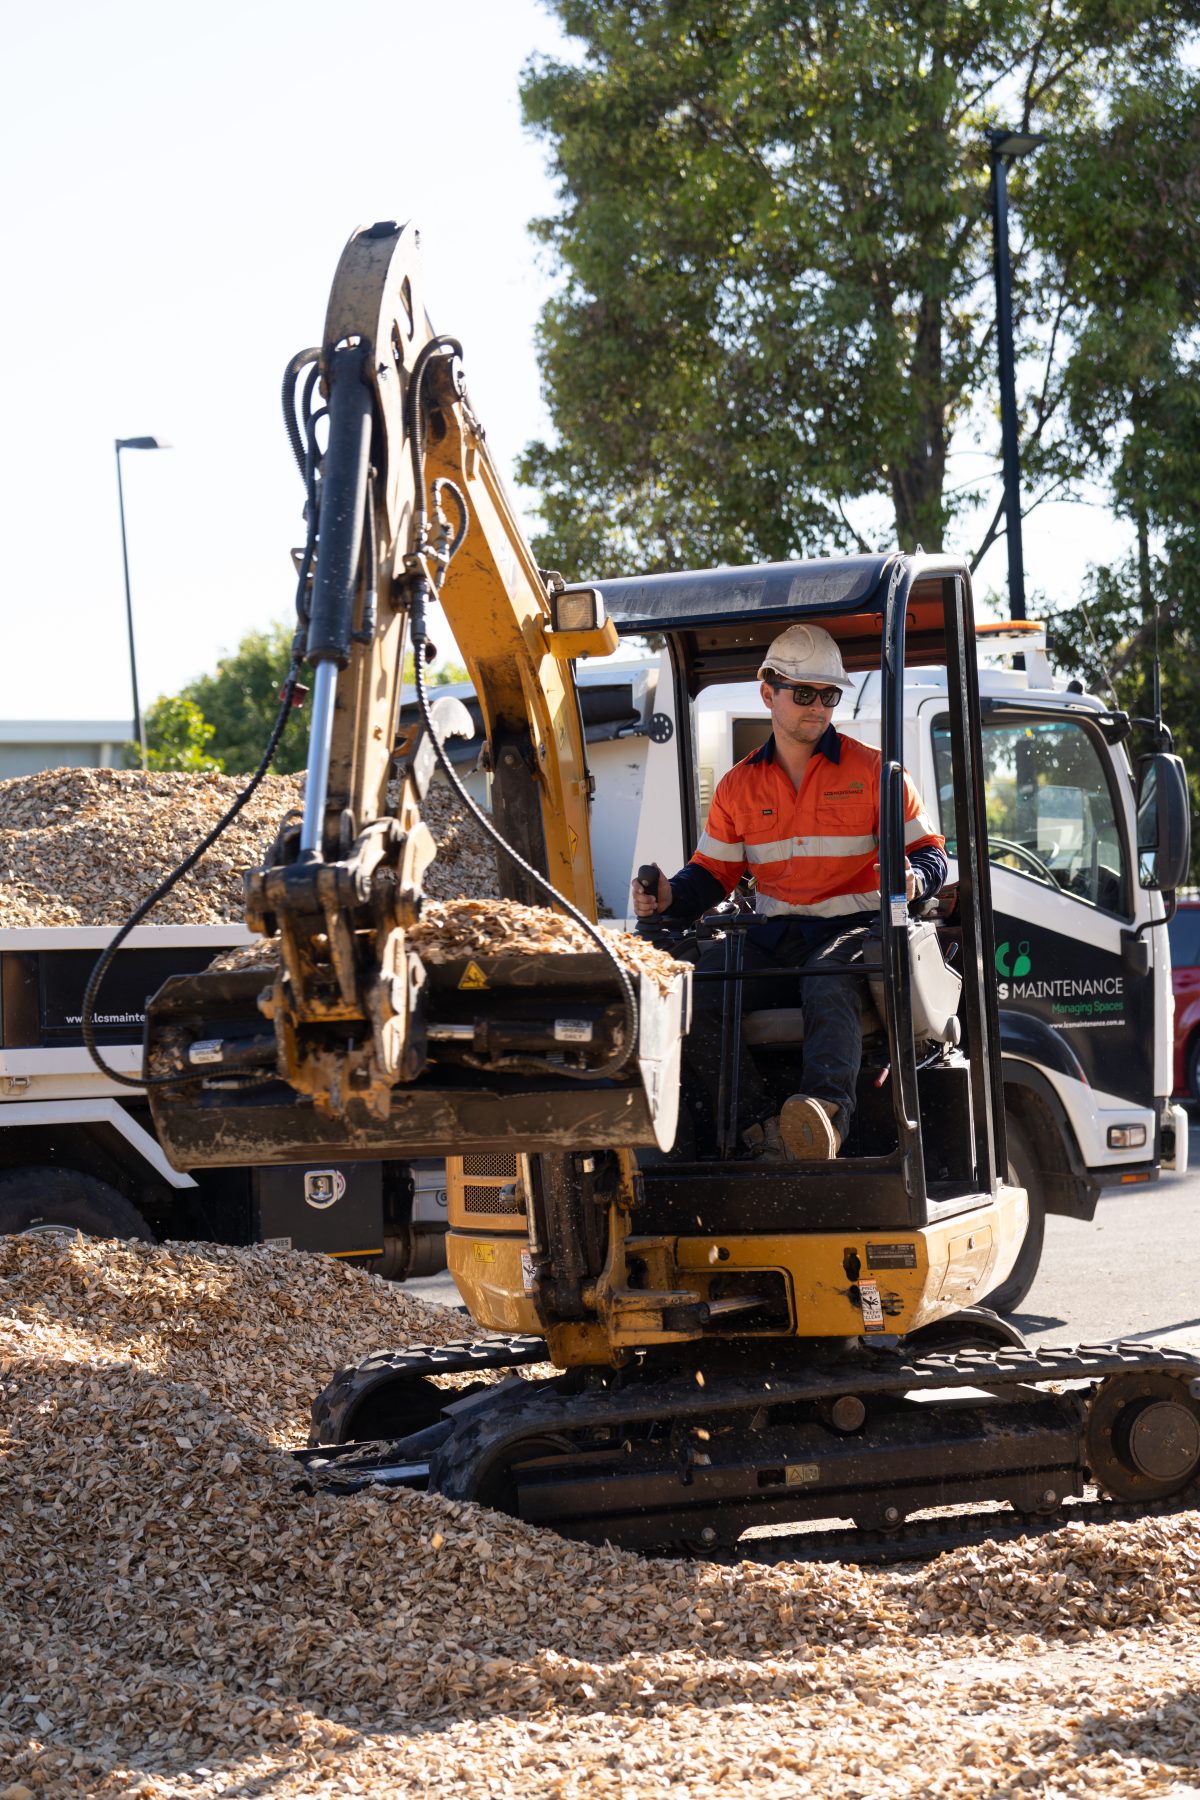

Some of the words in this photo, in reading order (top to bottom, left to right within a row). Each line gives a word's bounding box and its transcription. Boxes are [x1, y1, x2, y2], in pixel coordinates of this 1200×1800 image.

[997, 983, 1009, 1000] S
[1013, 977, 1124, 999] MAINTENANCE
[1052, 1003, 1093, 1016] Managing
[1094, 1000, 1124, 1014] Spaces
[65, 1012, 146, 1024] ww.lcsmainte
